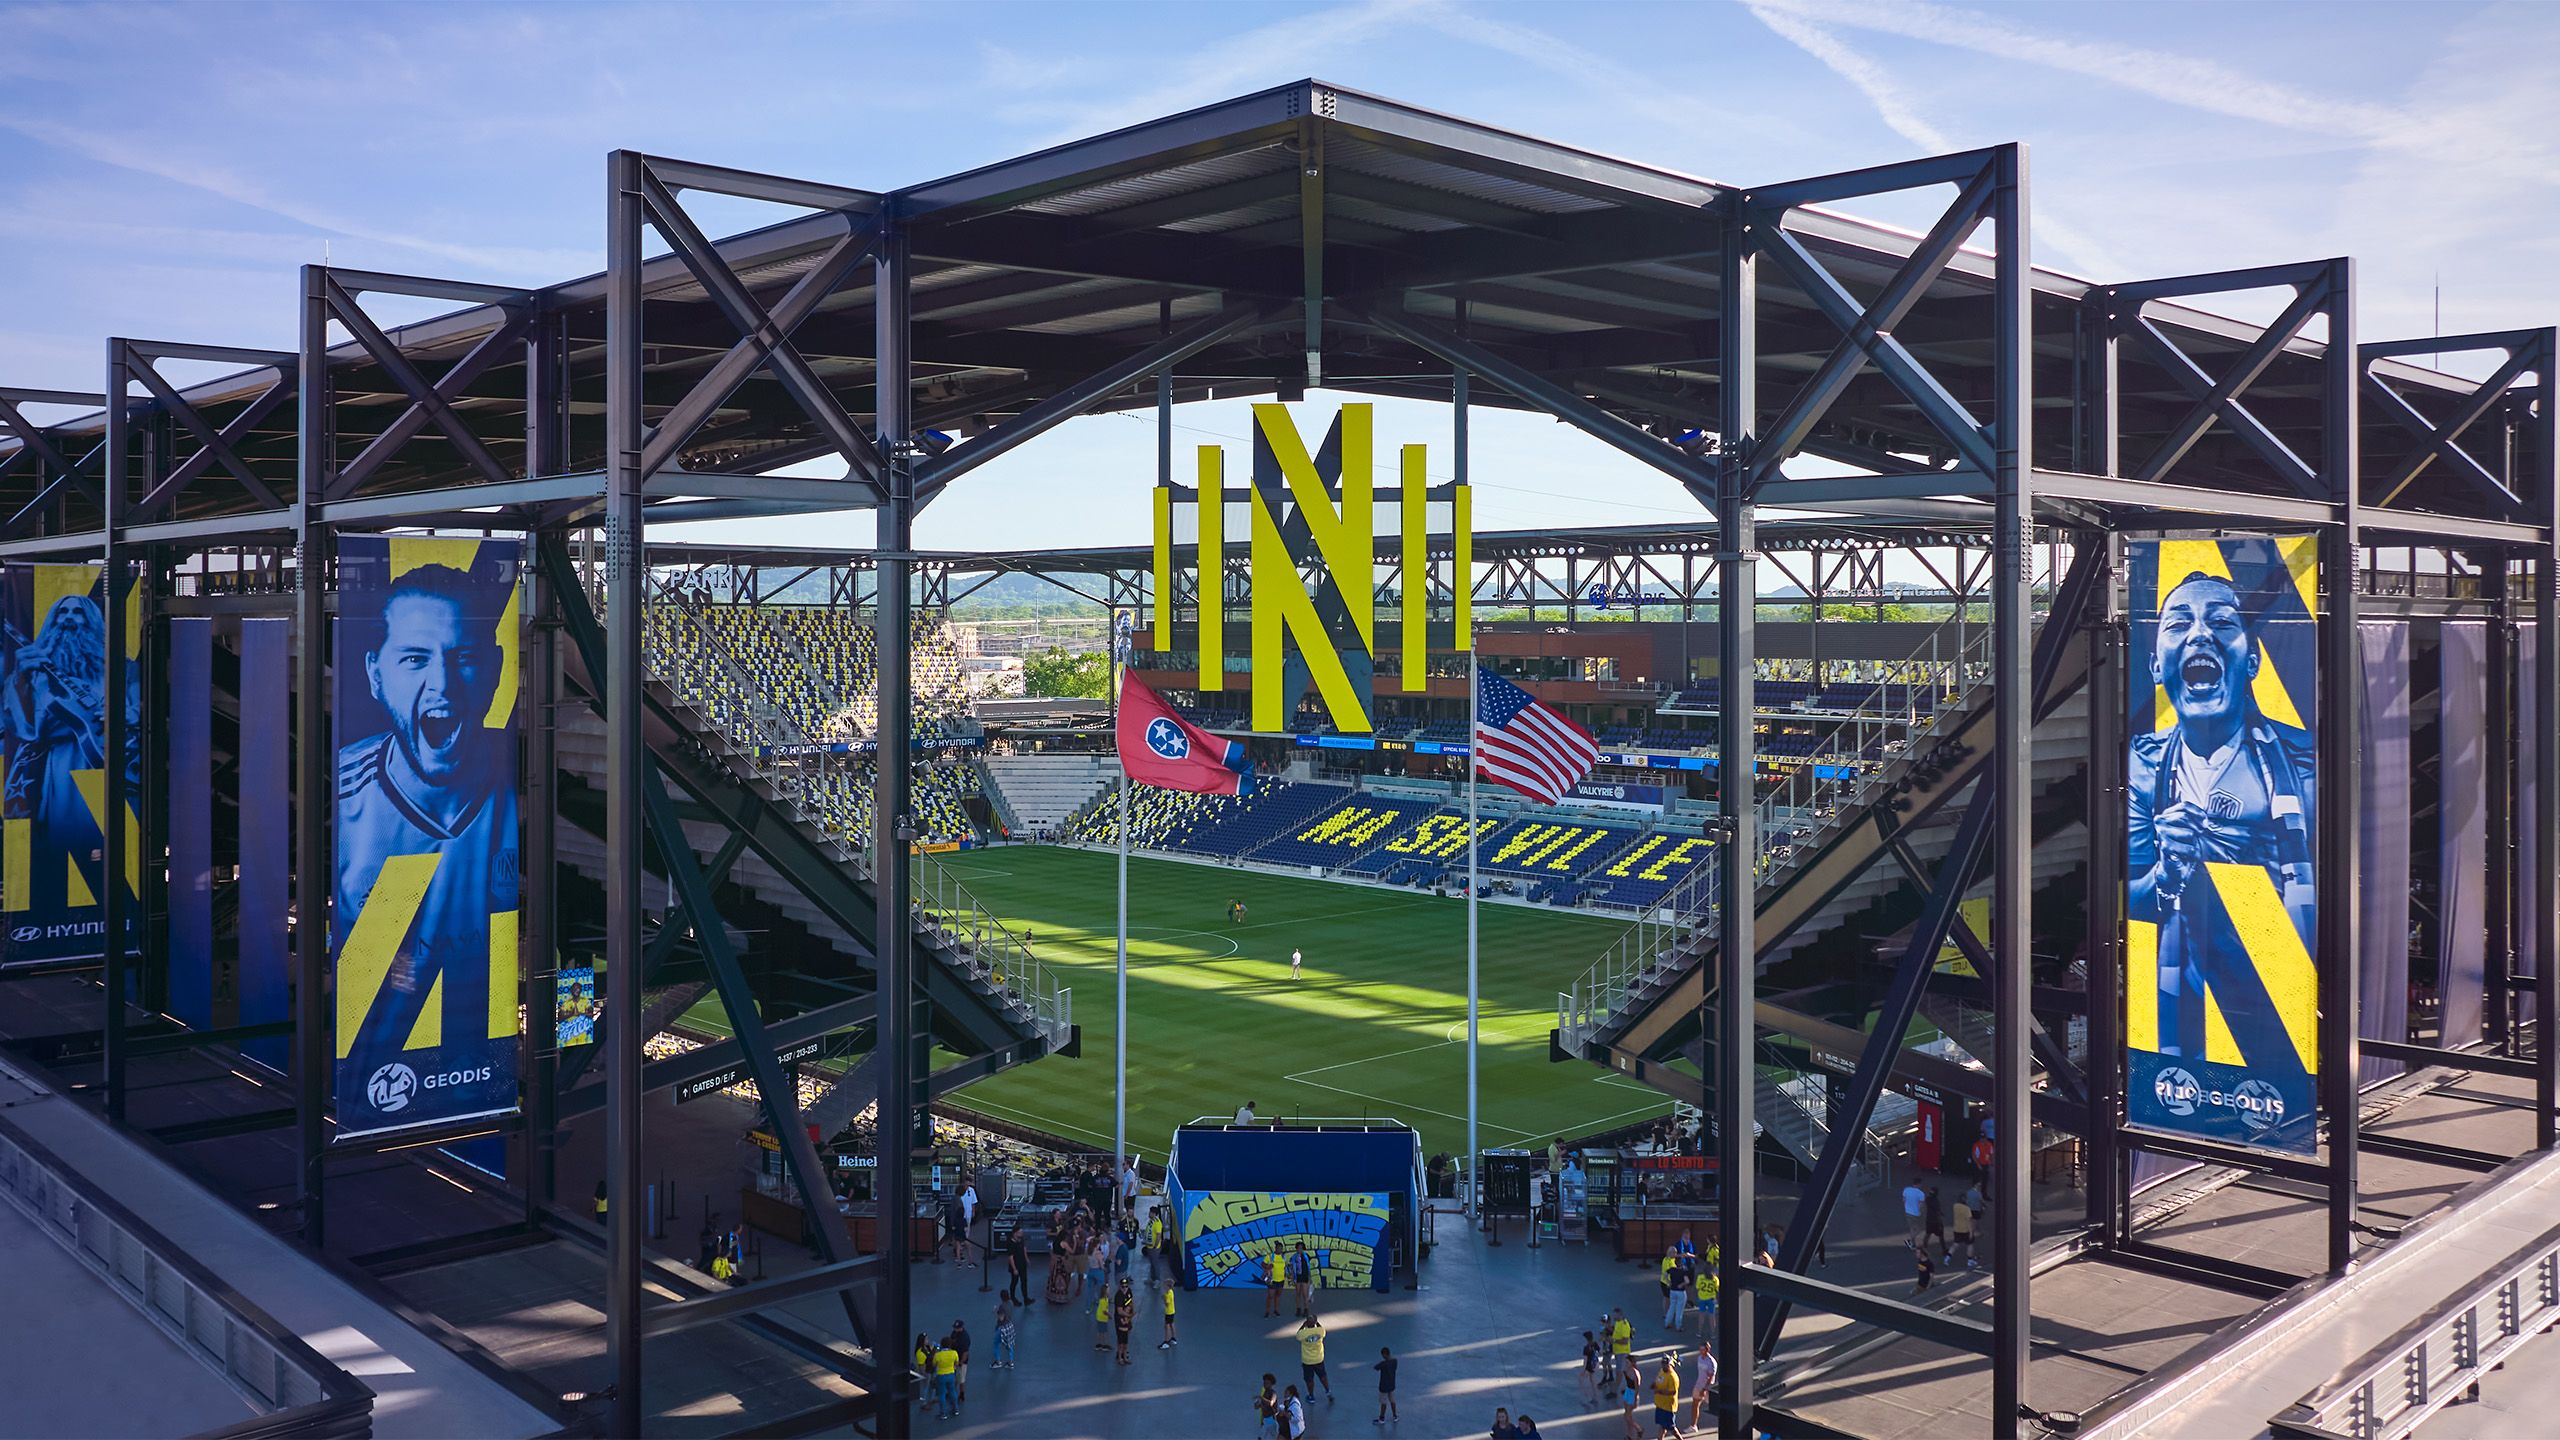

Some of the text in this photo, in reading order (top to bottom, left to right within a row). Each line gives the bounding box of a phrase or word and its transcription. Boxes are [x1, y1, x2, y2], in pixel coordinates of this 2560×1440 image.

[670, 569, 731, 588] PARK
[938, 737, 975, 747] HYUNDAI
[1578, 785, 1613, 797] VALKYRIE
[47, 919, 130, 938] HYUNI
[558, 969, 593, 979] SOCCER
[558, 984, 593, 994] SOER
[424, 1067, 491, 1089] GEODIS
[693, 1077, 714, 1093] GATES
[1700, 1281, 1714, 1293] 25
